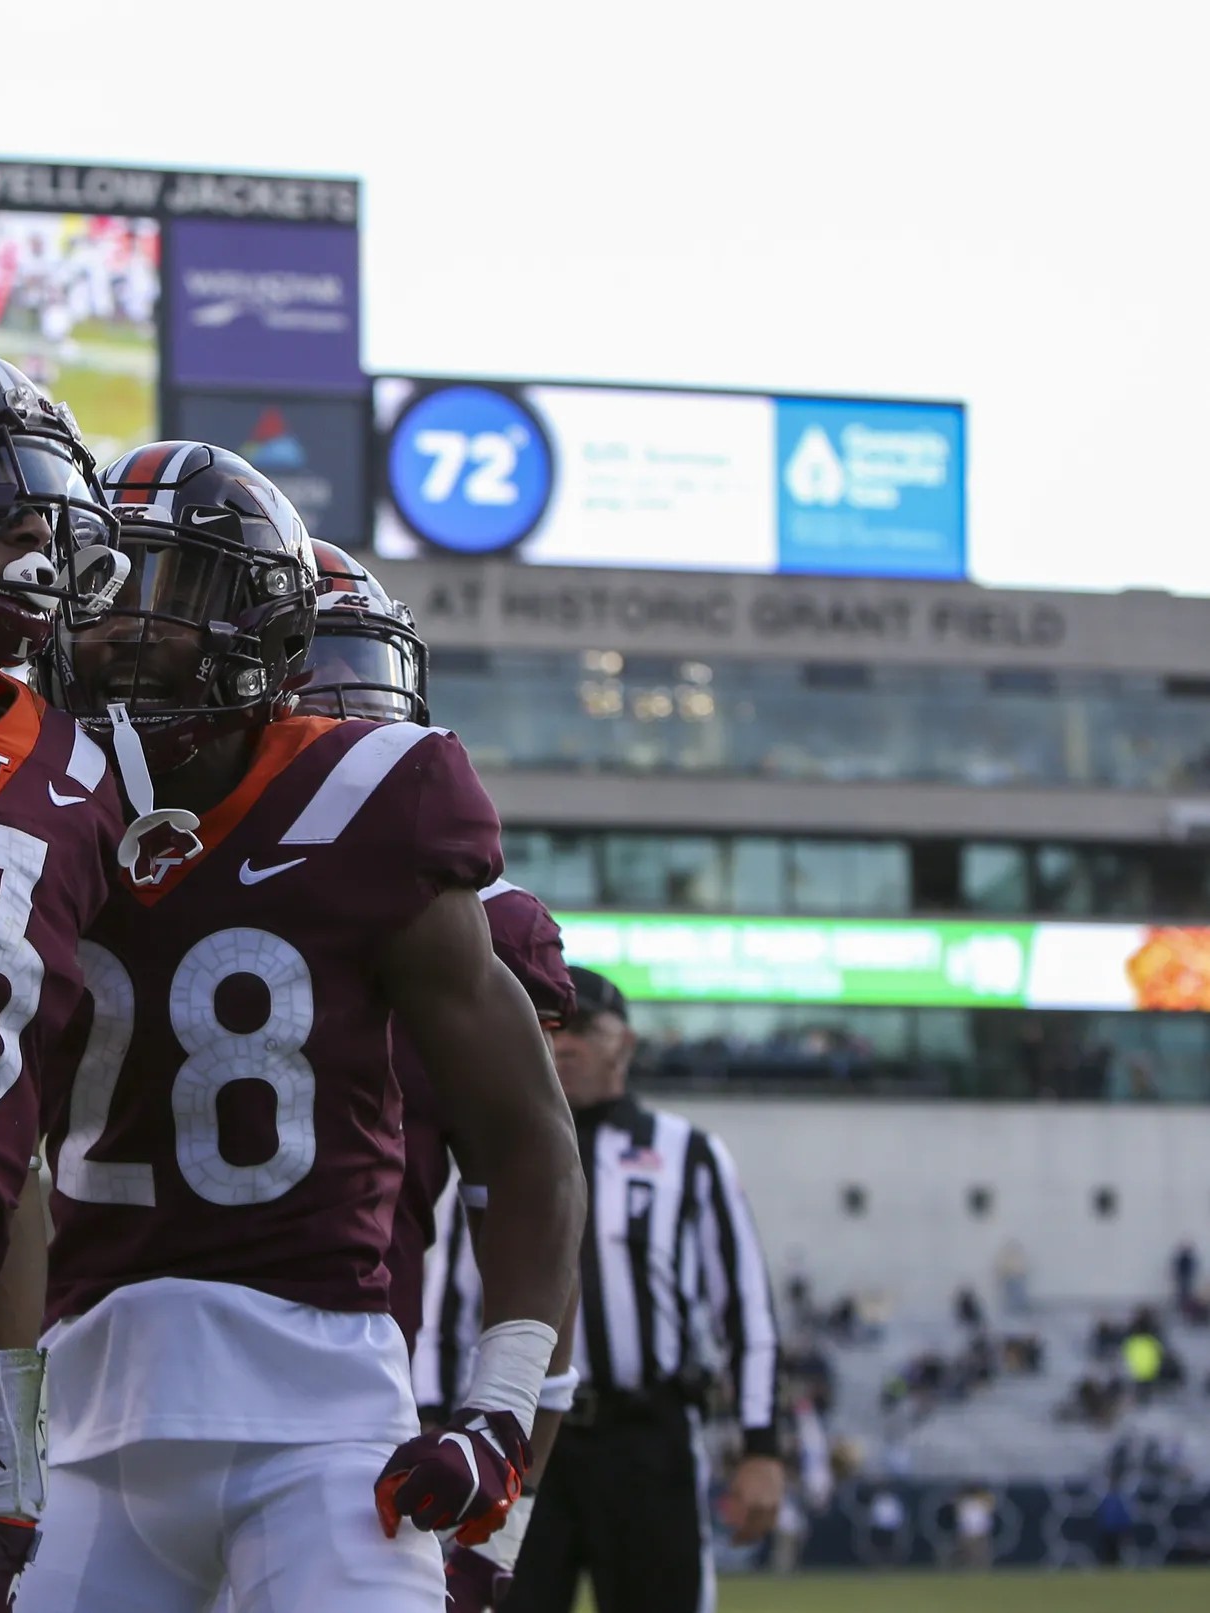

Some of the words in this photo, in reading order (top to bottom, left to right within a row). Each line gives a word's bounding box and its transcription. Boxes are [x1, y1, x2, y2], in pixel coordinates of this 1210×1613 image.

[334, 594, 370, 609] ACC
[500, 585, 739, 639] HISTORIC
[747, 598, 910, 643] GRANT
[929, 604, 1065, 649] FIELD
[57, 926, 317, 1207] 28
